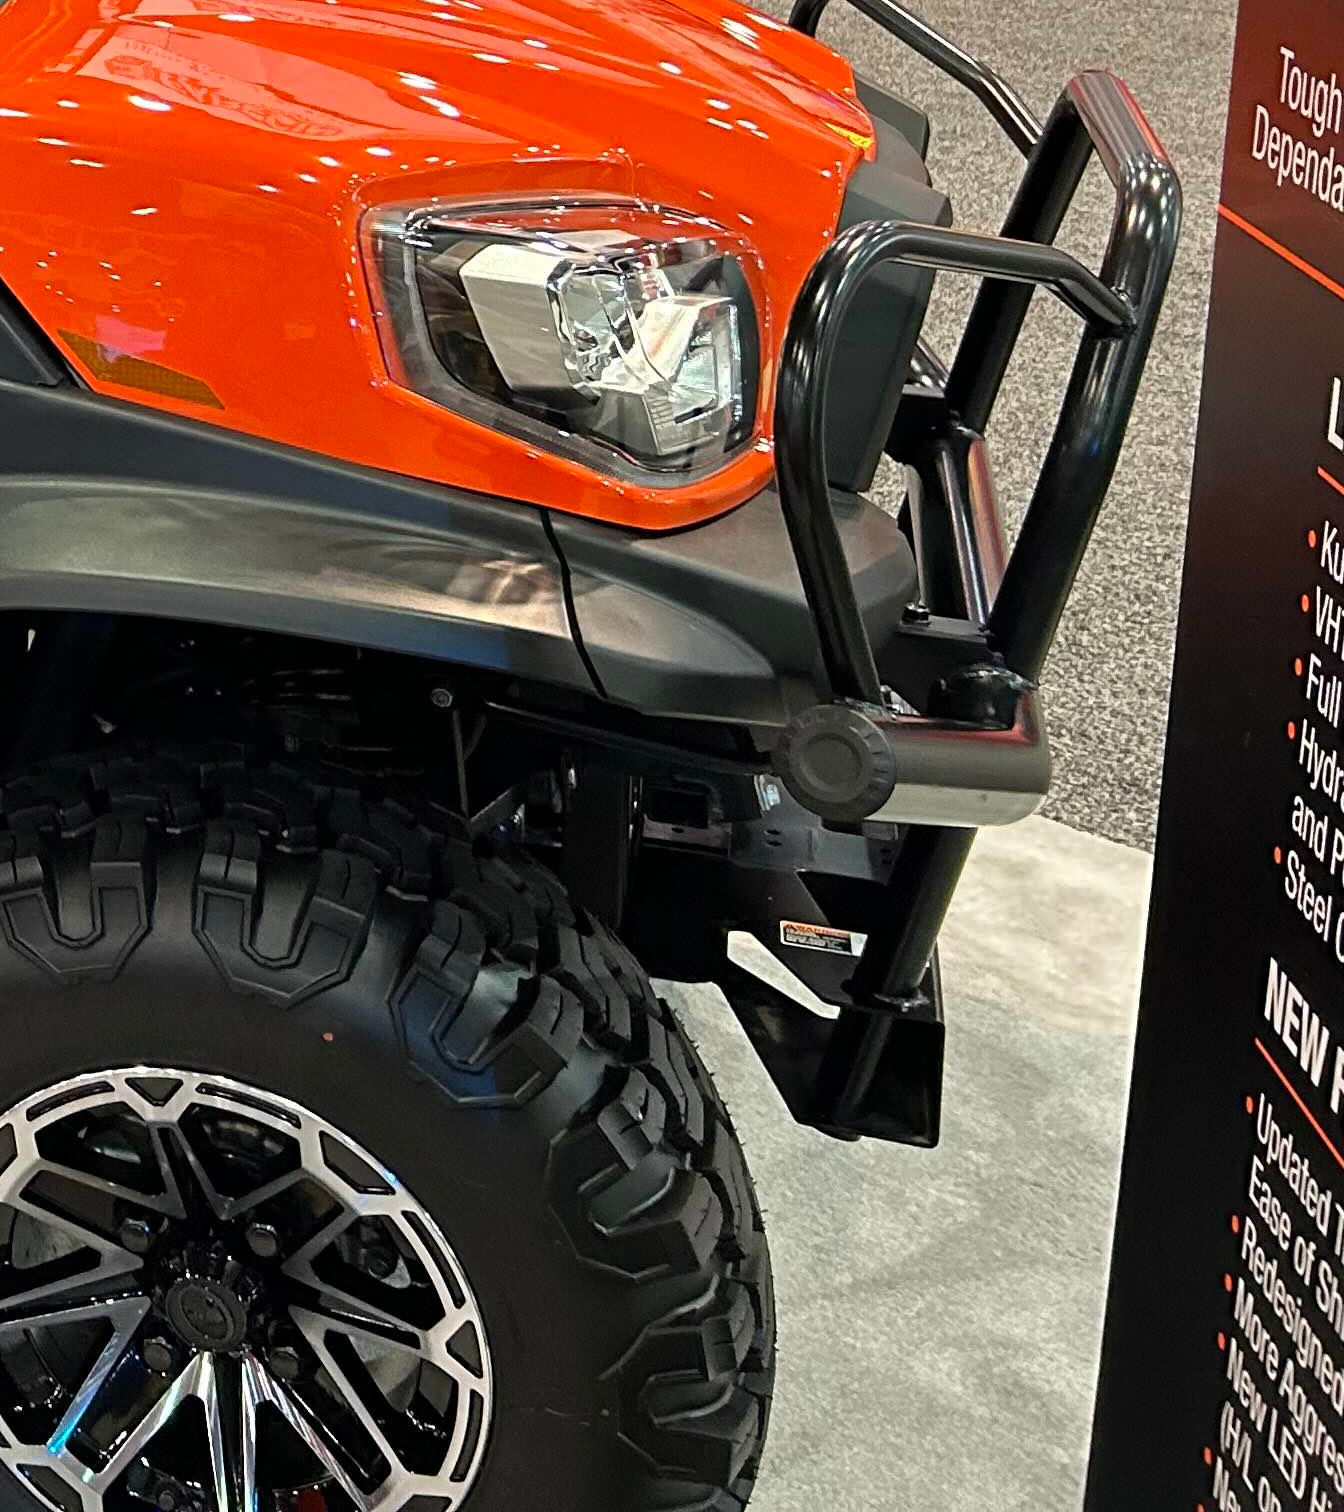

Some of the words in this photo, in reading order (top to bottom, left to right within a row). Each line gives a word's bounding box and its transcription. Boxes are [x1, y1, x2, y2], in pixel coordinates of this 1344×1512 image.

[1279, 46, 1342, 138] Tough
[1306, 652, 1342, 729] Full
[1292, 795, 1329, 863] and
[1284, 849, 1334, 943] Steel
[1264, 956, 1330, 1088] NEW
[1257, 1092, 1333, 1238] Updated
[1248, 1154, 1292, 1252] Ease
[1294, 1235, 1317, 1286] of
[1234, 1277, 1279, 1381] More
[1226, 1336, 1268, 1433] New
[1268, 1408, 1307, 1500] LED
